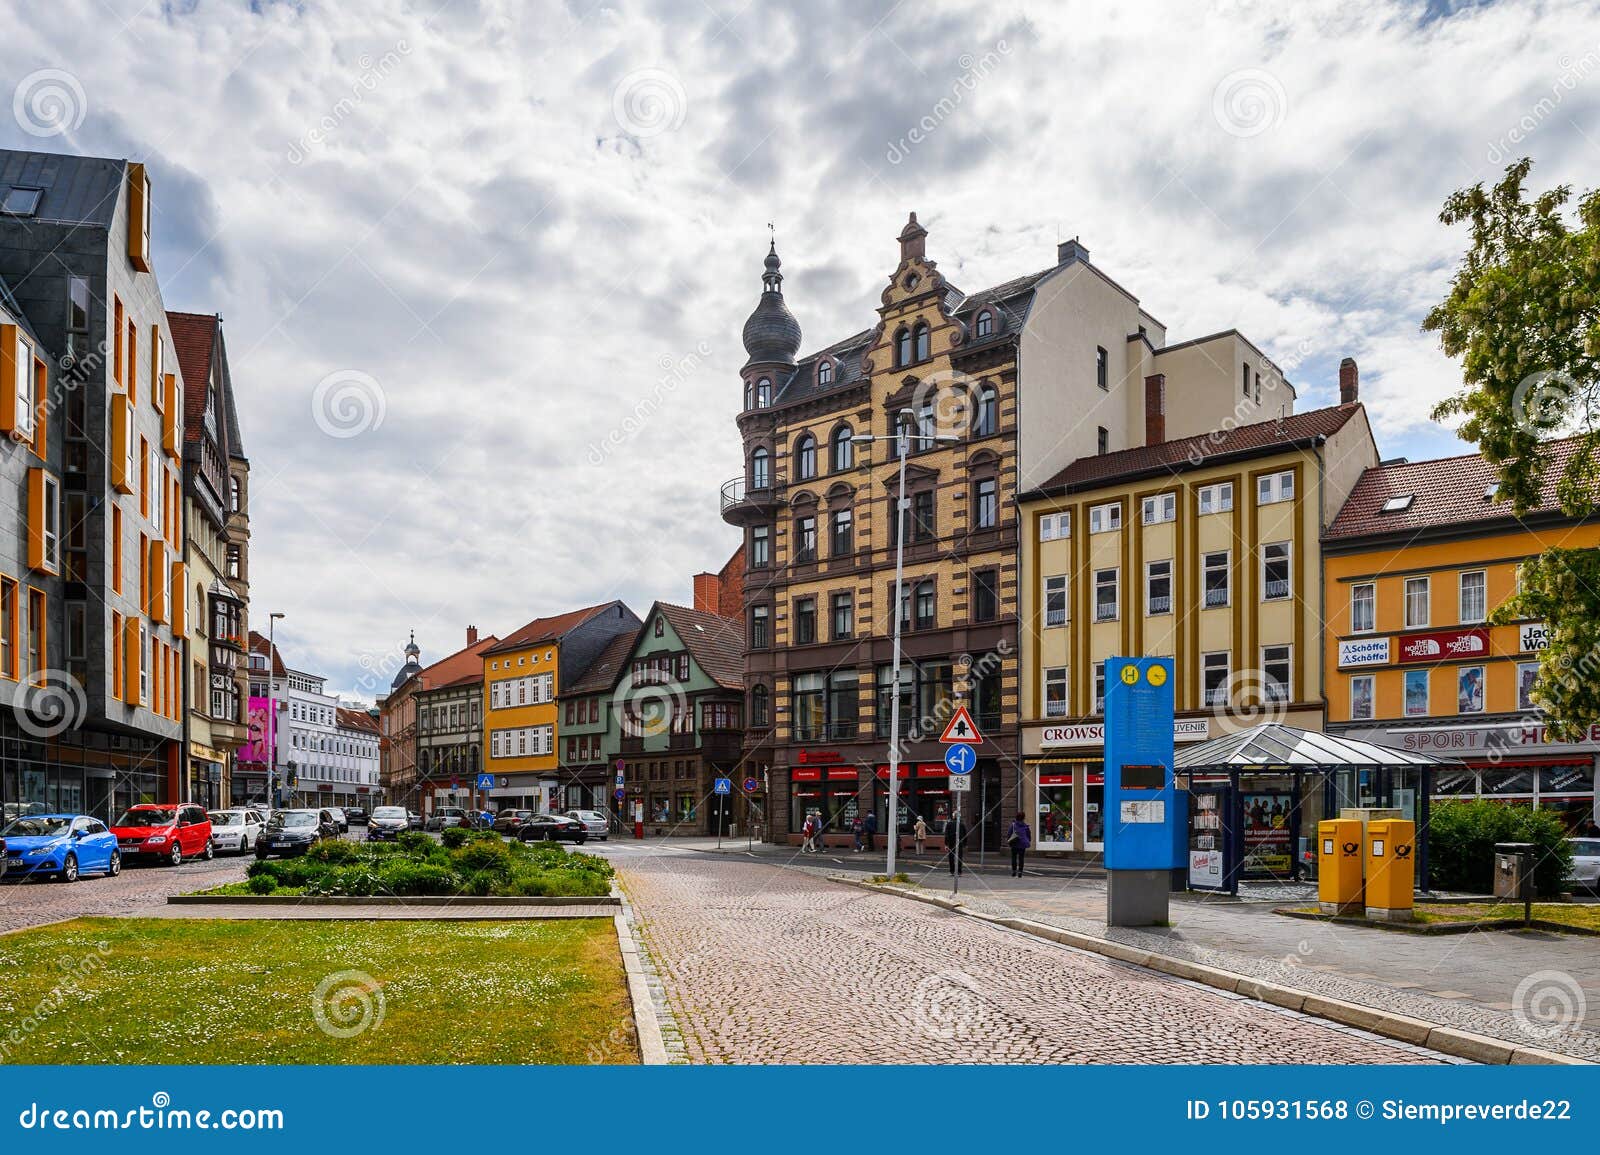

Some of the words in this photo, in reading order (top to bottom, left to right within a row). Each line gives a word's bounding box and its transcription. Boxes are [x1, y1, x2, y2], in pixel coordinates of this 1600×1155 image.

[1352, 642, 1387, 652] Schöffel
[1352, 653, 1387, 662] Schöffel
[1125, 669, 1135, 681] H
[1404, 731, 1478, 750] SPORT
